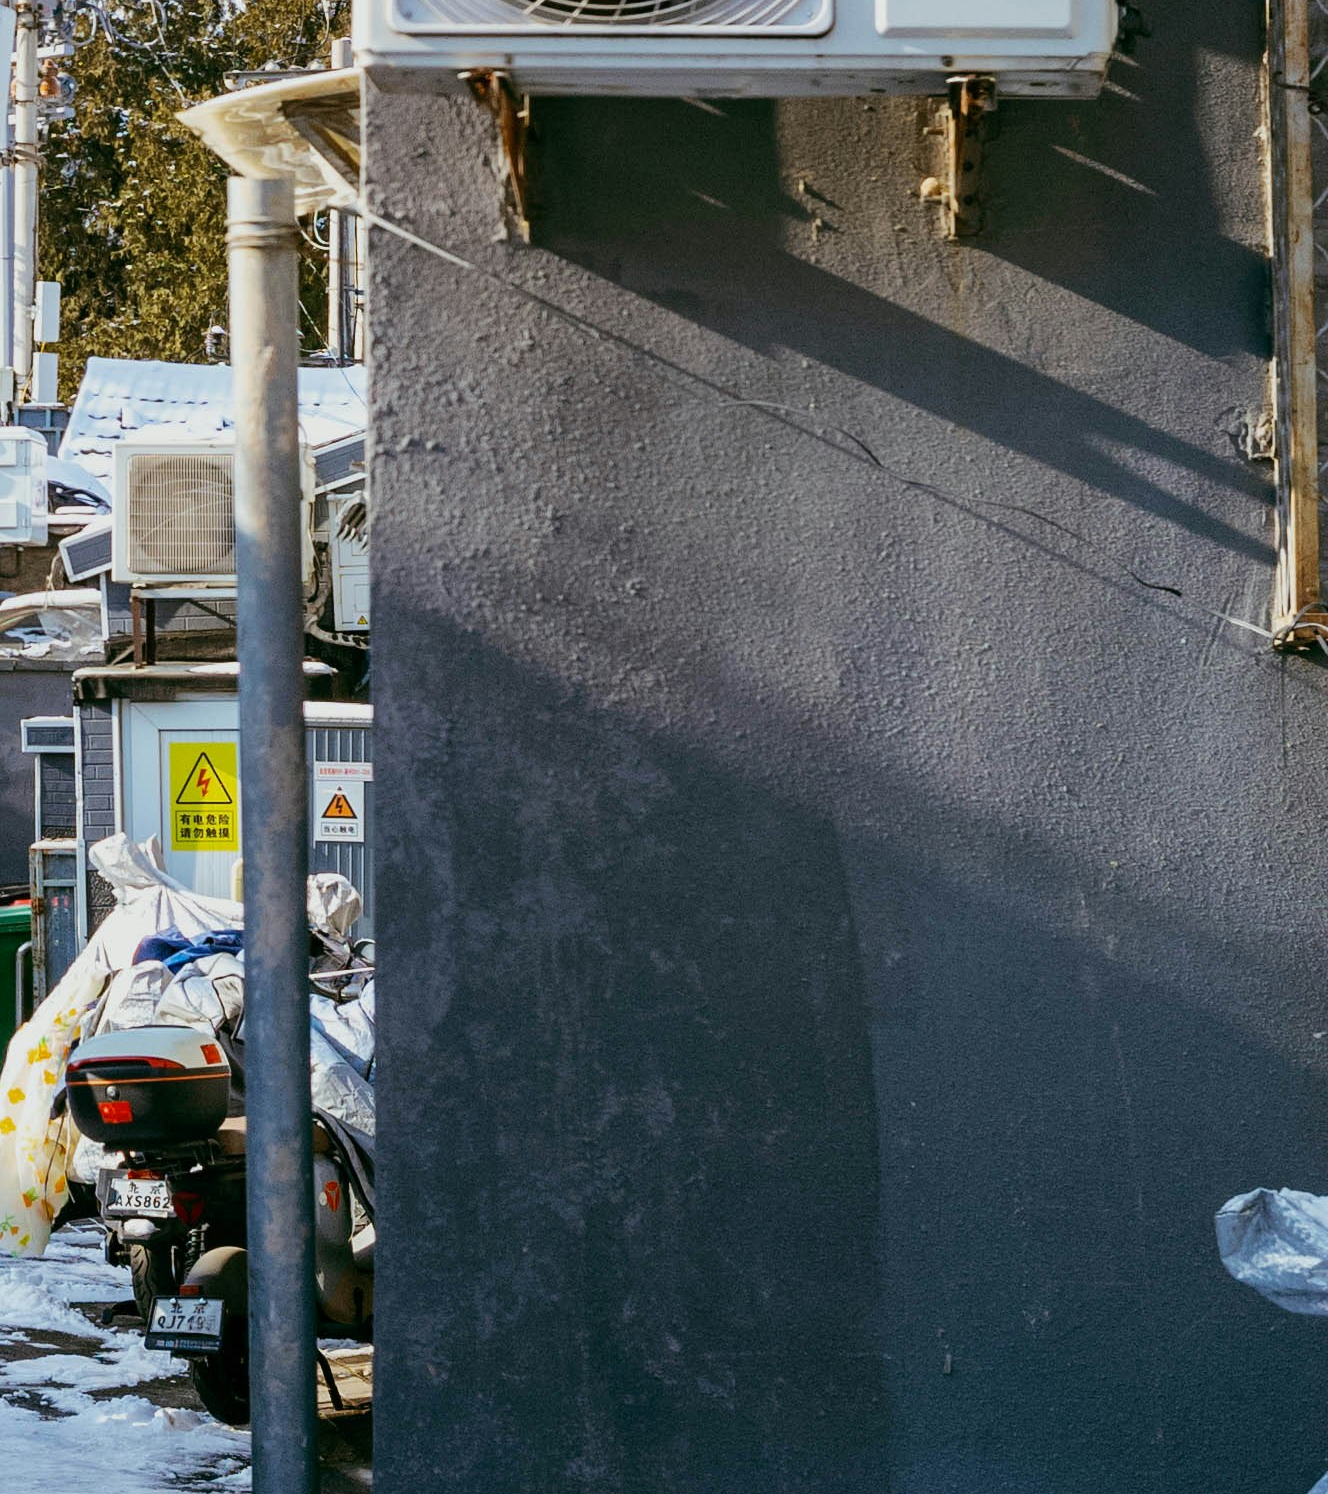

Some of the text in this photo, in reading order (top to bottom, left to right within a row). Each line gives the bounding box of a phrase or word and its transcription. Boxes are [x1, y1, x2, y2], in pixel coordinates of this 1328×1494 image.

[179, 813, 230, 826] 有电危险
[180, 827, 230, 839] 请勿触摸
[128, 1182, 162, 1194] 北京
[170, 1301, 205, 1314] 北京
